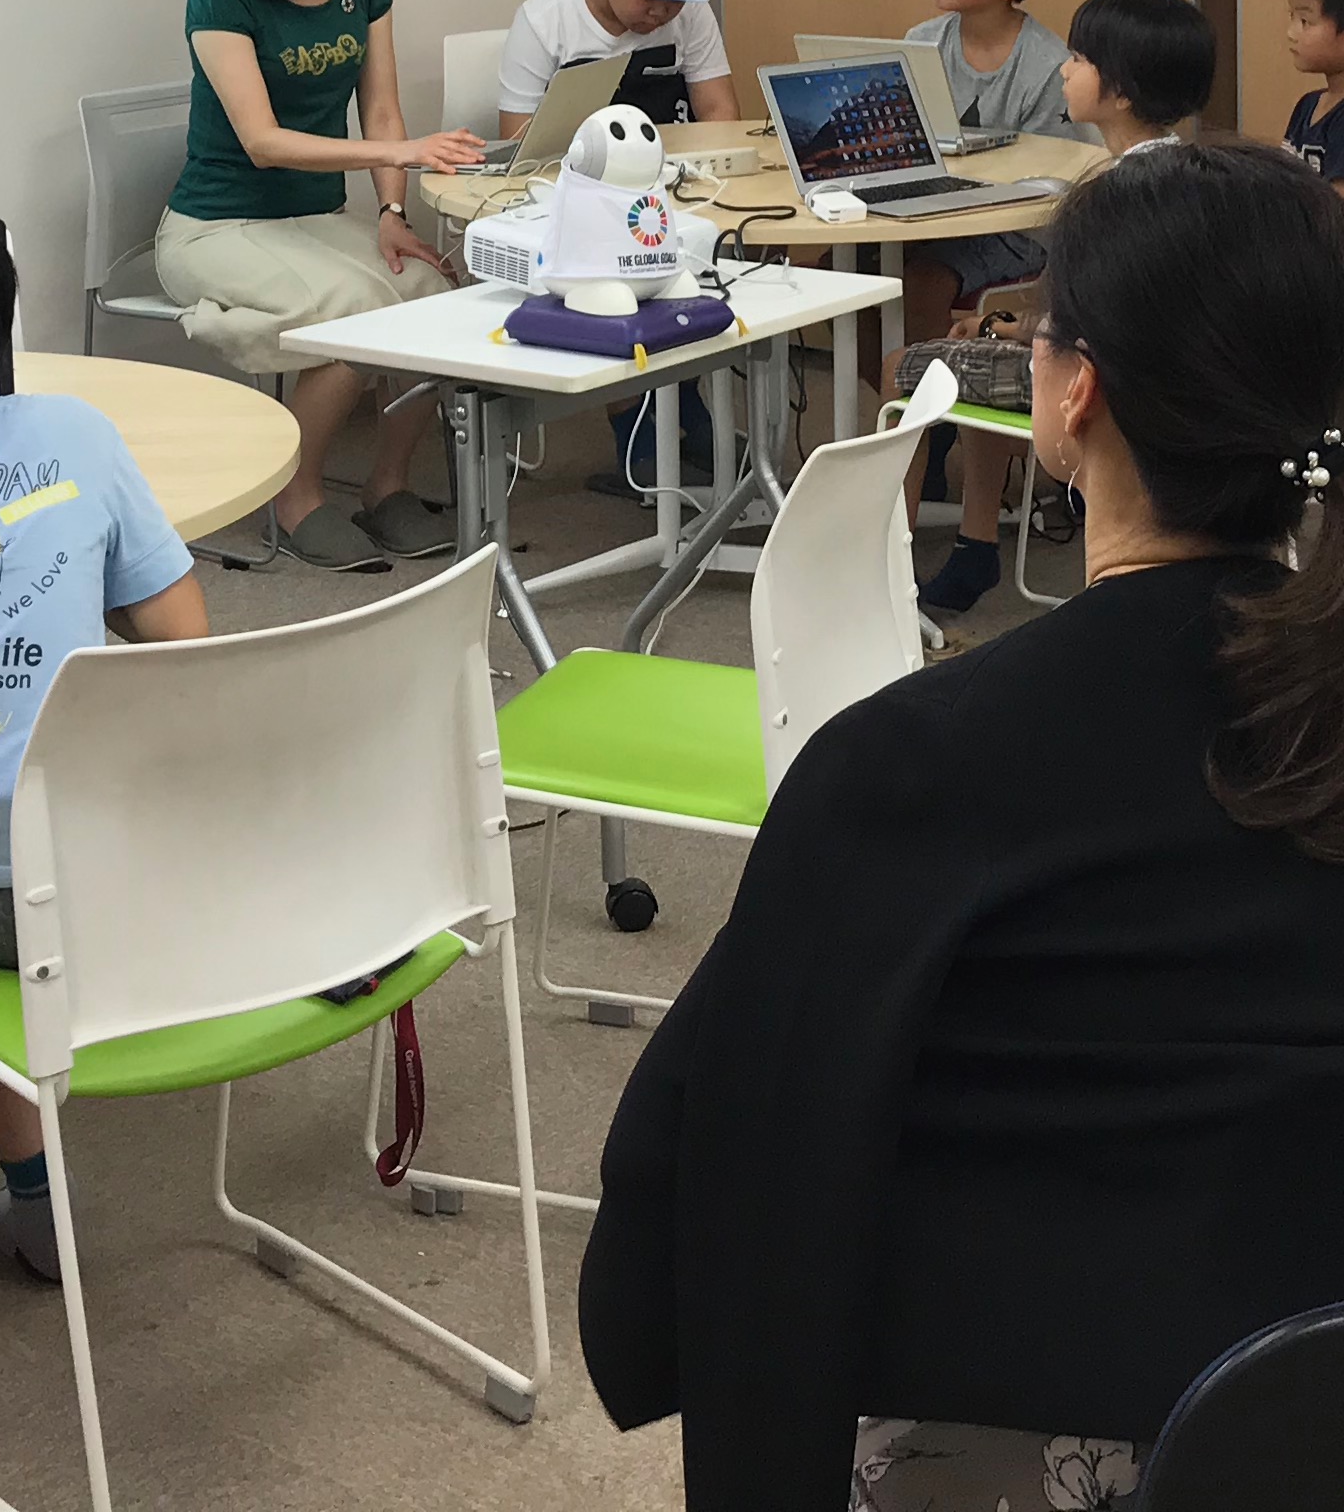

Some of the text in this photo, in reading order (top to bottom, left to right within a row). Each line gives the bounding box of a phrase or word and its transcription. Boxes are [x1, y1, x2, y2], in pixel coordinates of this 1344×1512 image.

[618, 255, 633, 267] THE
[634, 253, 659, 266] GLOBAL
[2, 594, 33, 619] we
[30, 551, 68, 595] love
